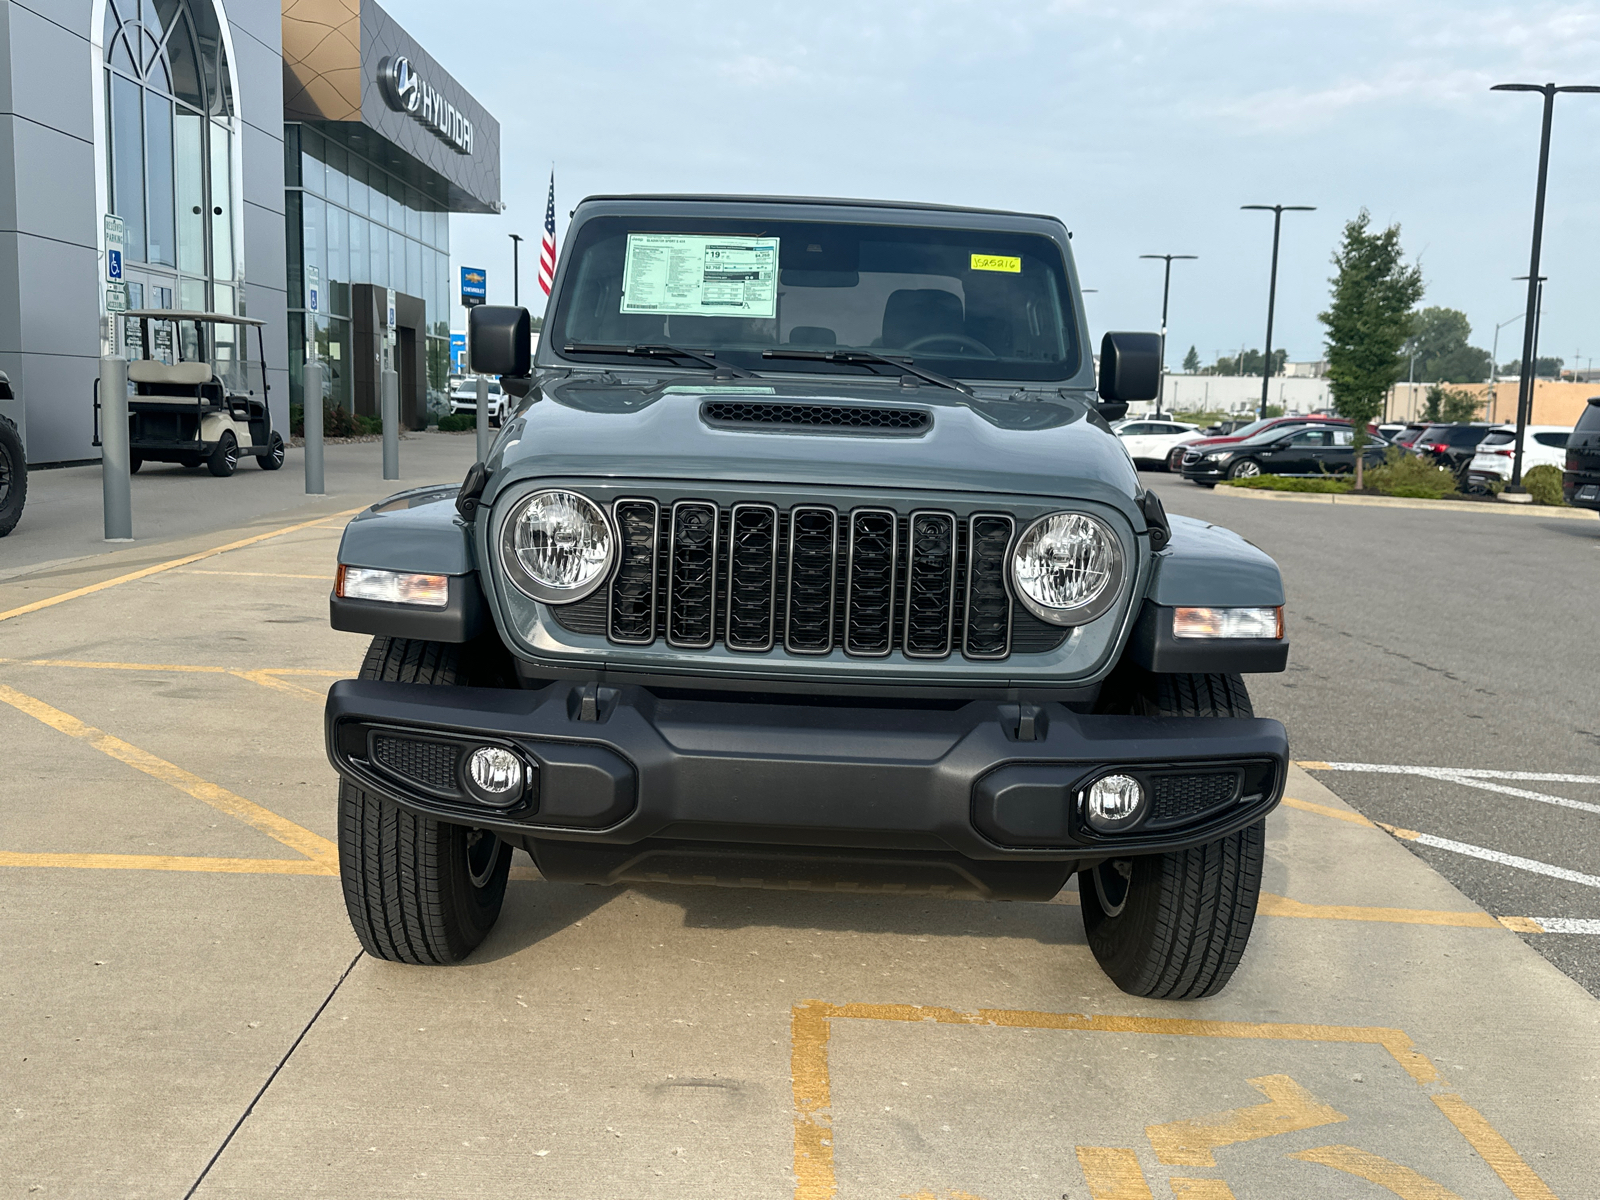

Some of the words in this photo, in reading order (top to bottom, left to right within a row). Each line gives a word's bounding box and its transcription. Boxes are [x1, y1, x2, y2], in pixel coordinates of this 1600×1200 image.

[423, 80, 474, 155] HYUNDAI
[106, 232, 123, 245] PARKING
[463, 286, 485, 294] CHEVROLET
[742, 301, 750, 309] A
